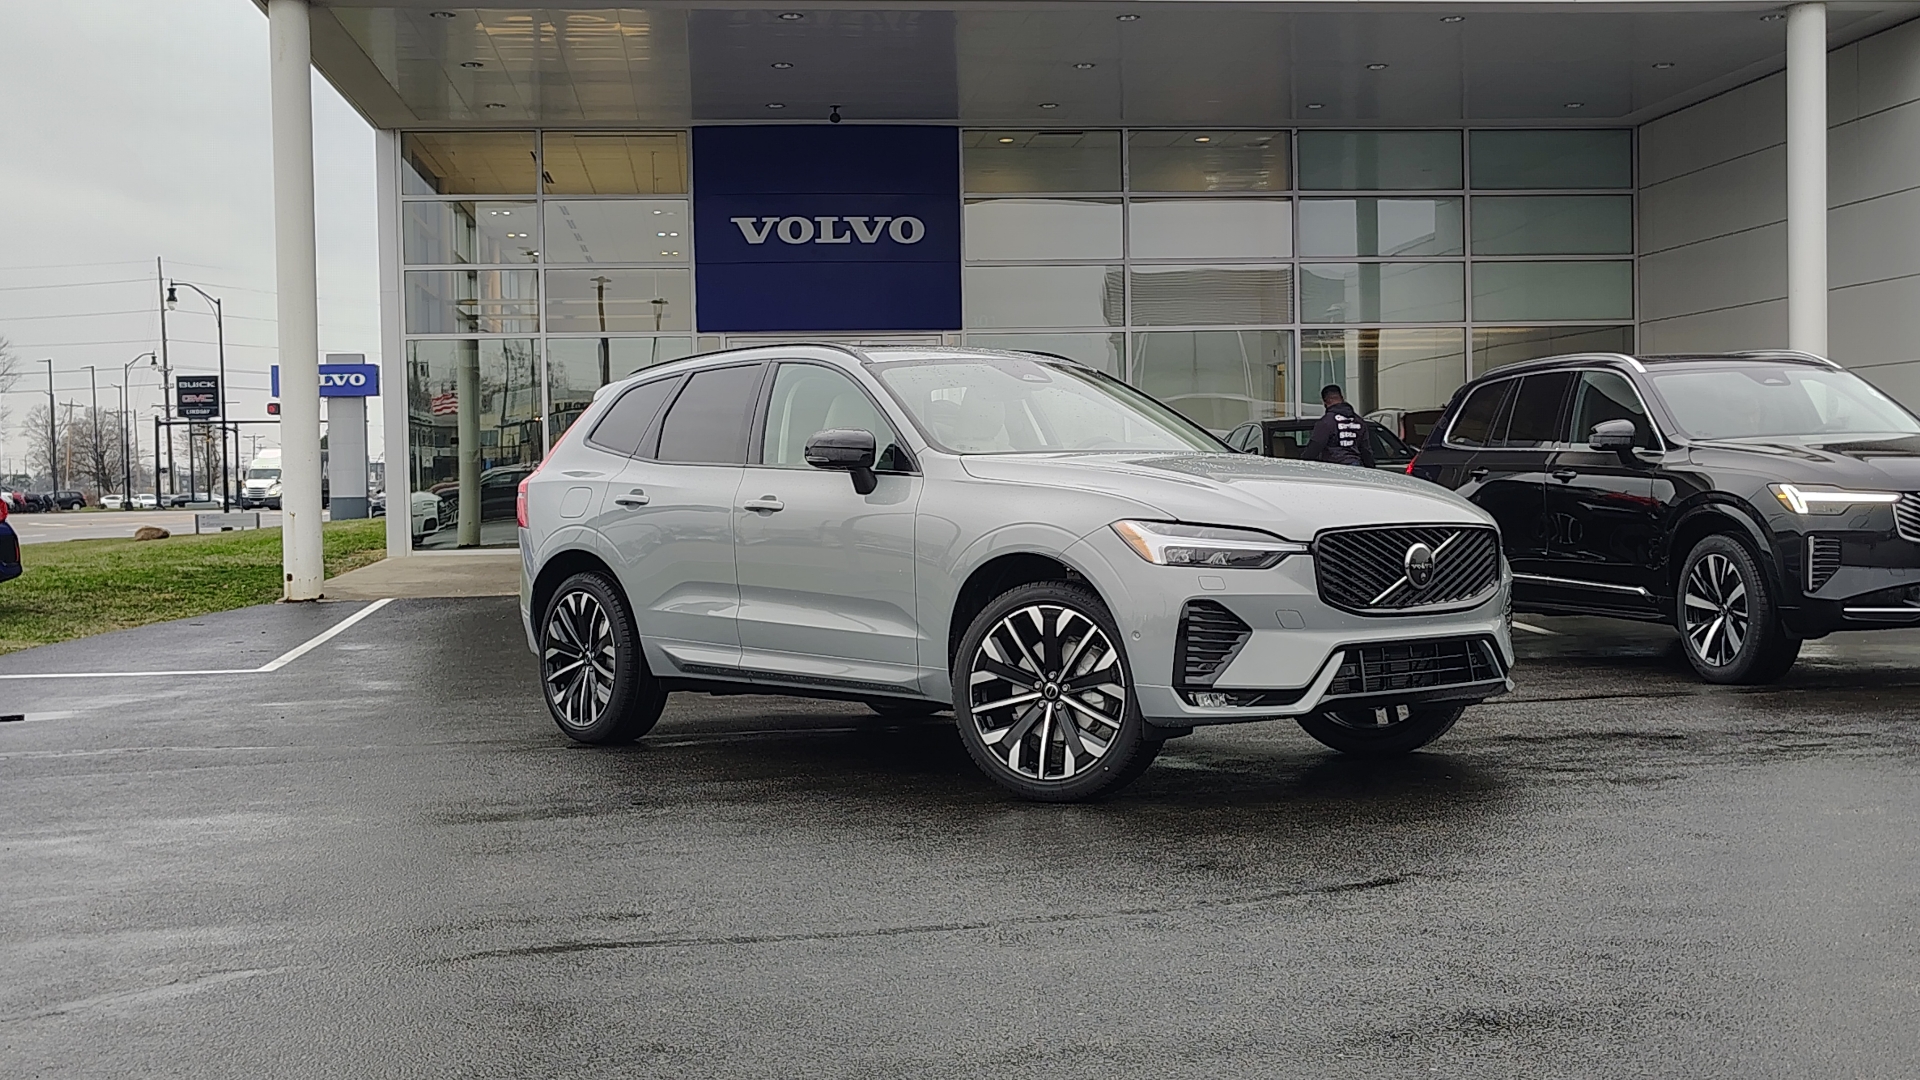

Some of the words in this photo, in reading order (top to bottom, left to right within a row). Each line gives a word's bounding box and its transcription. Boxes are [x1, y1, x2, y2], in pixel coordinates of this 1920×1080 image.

[730, 216, 925, 244] VOLVO
[318, 373, 366, 386] LVO
[182, 394, 214, 403] GMC
